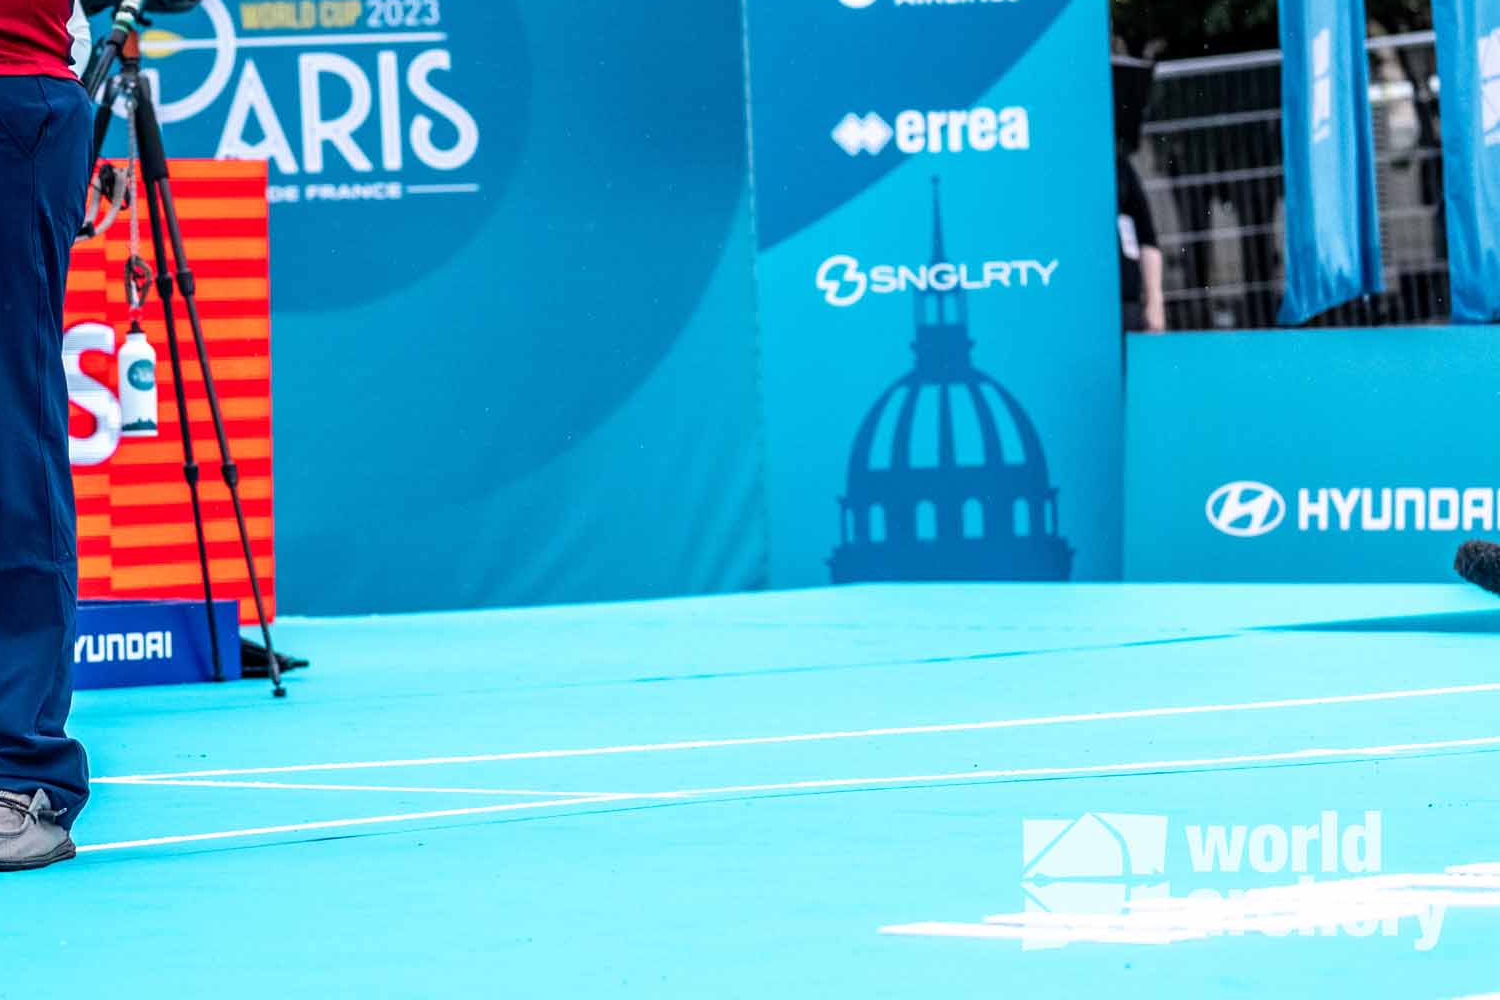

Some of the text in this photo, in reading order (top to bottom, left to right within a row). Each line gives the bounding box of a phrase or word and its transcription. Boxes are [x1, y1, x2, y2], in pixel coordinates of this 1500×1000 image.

[241, 1, 317, 30] WORLD
[894, 106, 1030, 155] errea
[306, 183, 402, 202] FRANCE
[869, 259, 1060, 294] SNGLRTY
[1298, 487, 1500, 531] HYUNDA
[73, 630, 174, 662] YUNDAI
